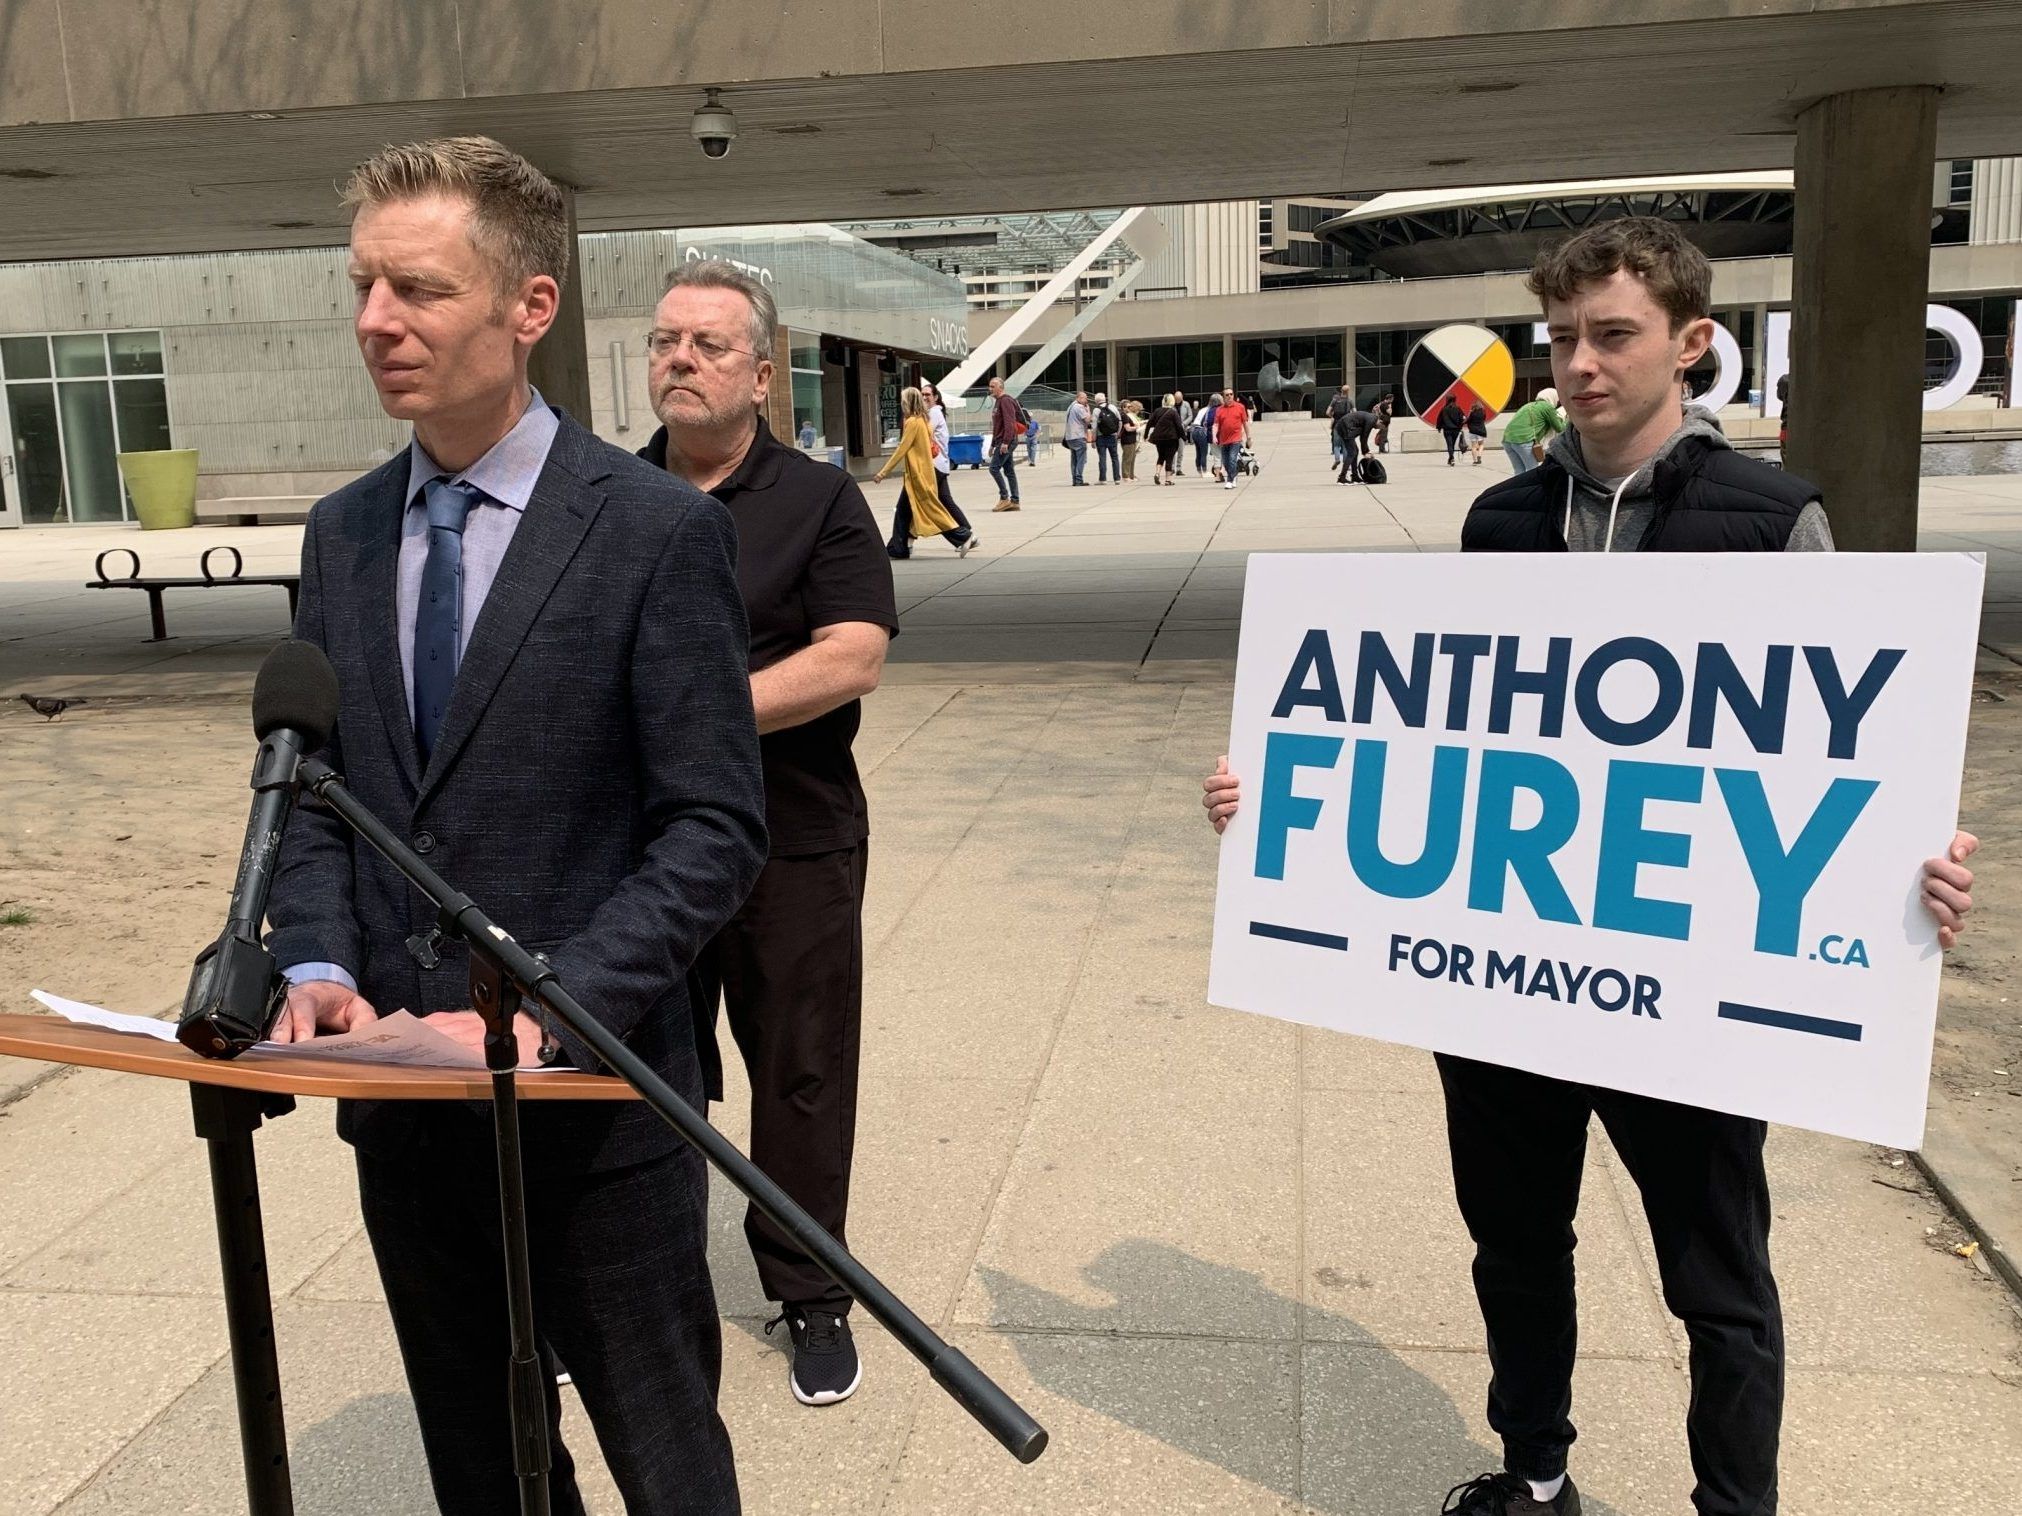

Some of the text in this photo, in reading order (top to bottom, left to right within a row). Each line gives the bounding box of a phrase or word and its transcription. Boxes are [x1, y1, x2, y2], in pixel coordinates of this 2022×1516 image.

[930, 317, 968, 357] SNACKS
[1270, 628, 1908, 761] ANTHONY
[1254, 731, 1882, 959] FUREY
[1388, 933, 1663, 1021] FOR MAYOR
